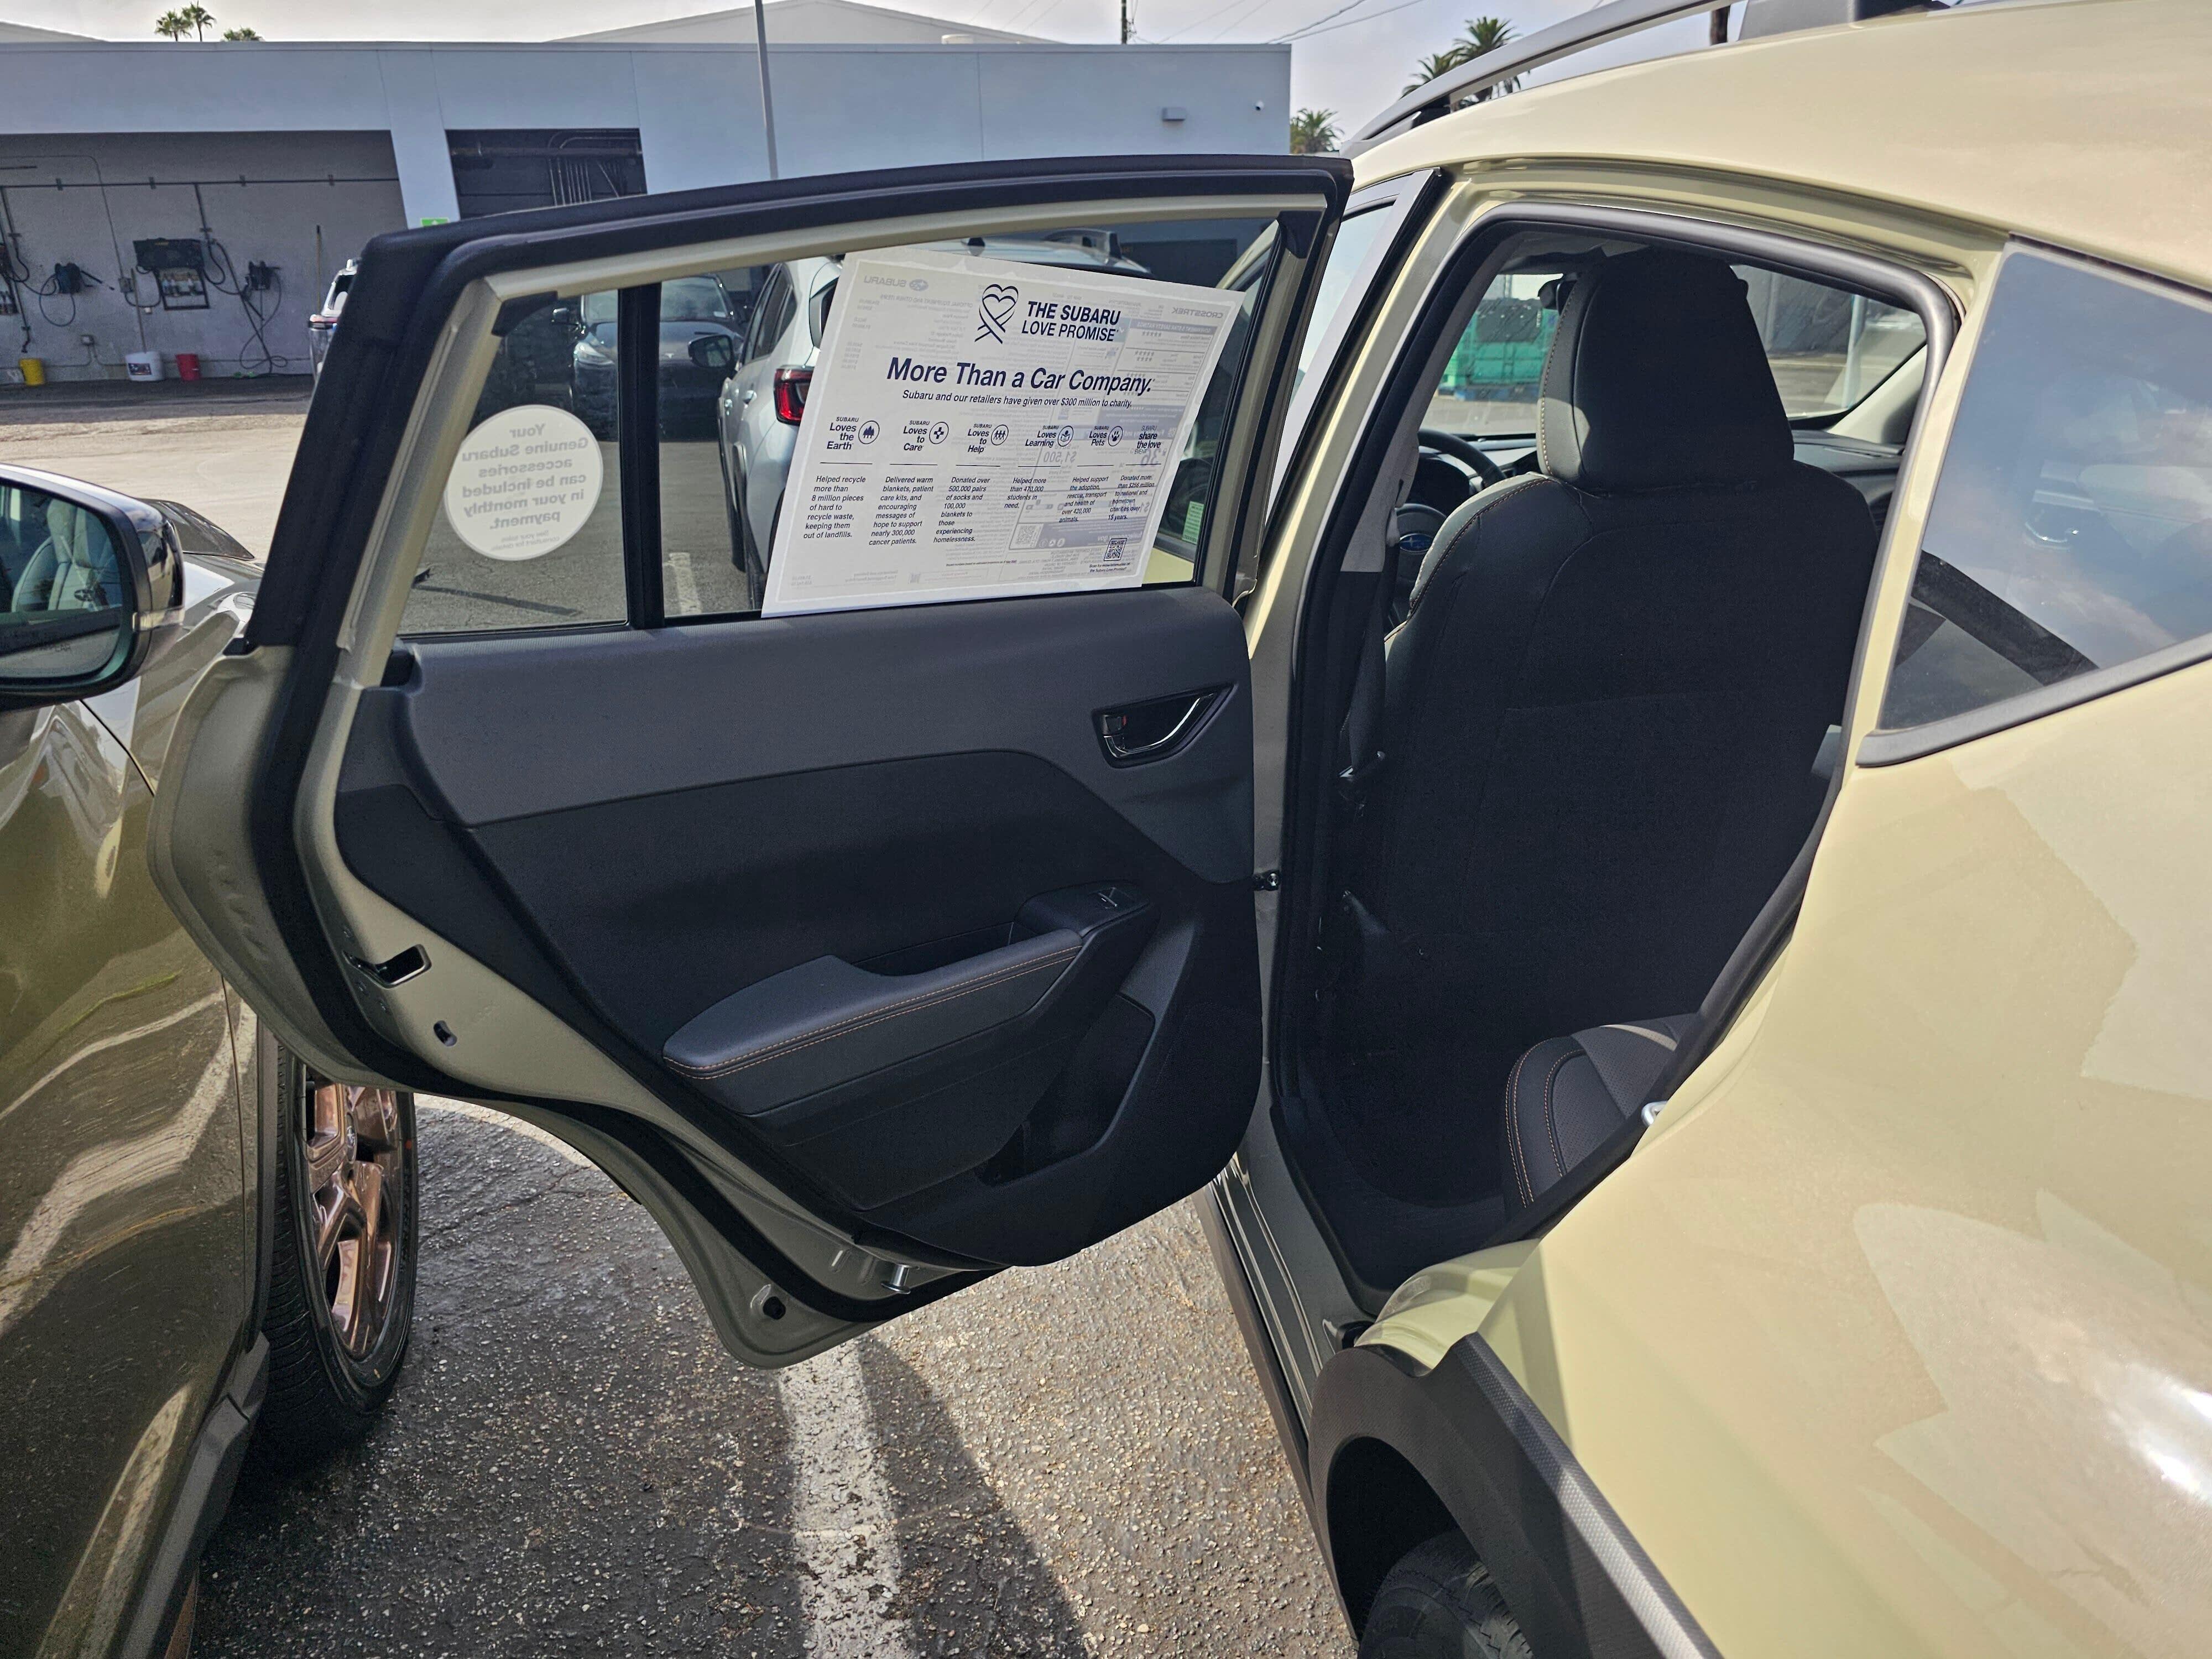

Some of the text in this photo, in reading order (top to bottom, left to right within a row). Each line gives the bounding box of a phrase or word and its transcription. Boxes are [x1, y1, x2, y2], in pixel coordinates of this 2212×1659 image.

[1027, 301, 1057, 319] THE
[1060, 305, 1120, 325] SUBARU
[1022, 320, 1114, 342] LOVE PROMISE
[887, 357, 1152, 395] More Than a Car Company.
[902, 390, 933, 400] Subaru
[936, 392, 951, 401] and
[969, 394, 1001, 404] retailers
[1004, 396, 1021, 404] have
[1023, 397, 1042, 407] given
[1061, 398, 1076, 406] $300
[1078, 398, 1100, 406] million
[1109, 398, 1132, 408] charity.
[830, 422, 856, 431] Loves
[903, 426, 927, 434] Loves
[827, 441, 852, 450] Earth
[1025, 439, 1053, 448] Learning
[968, 445, 984, 454] Help
